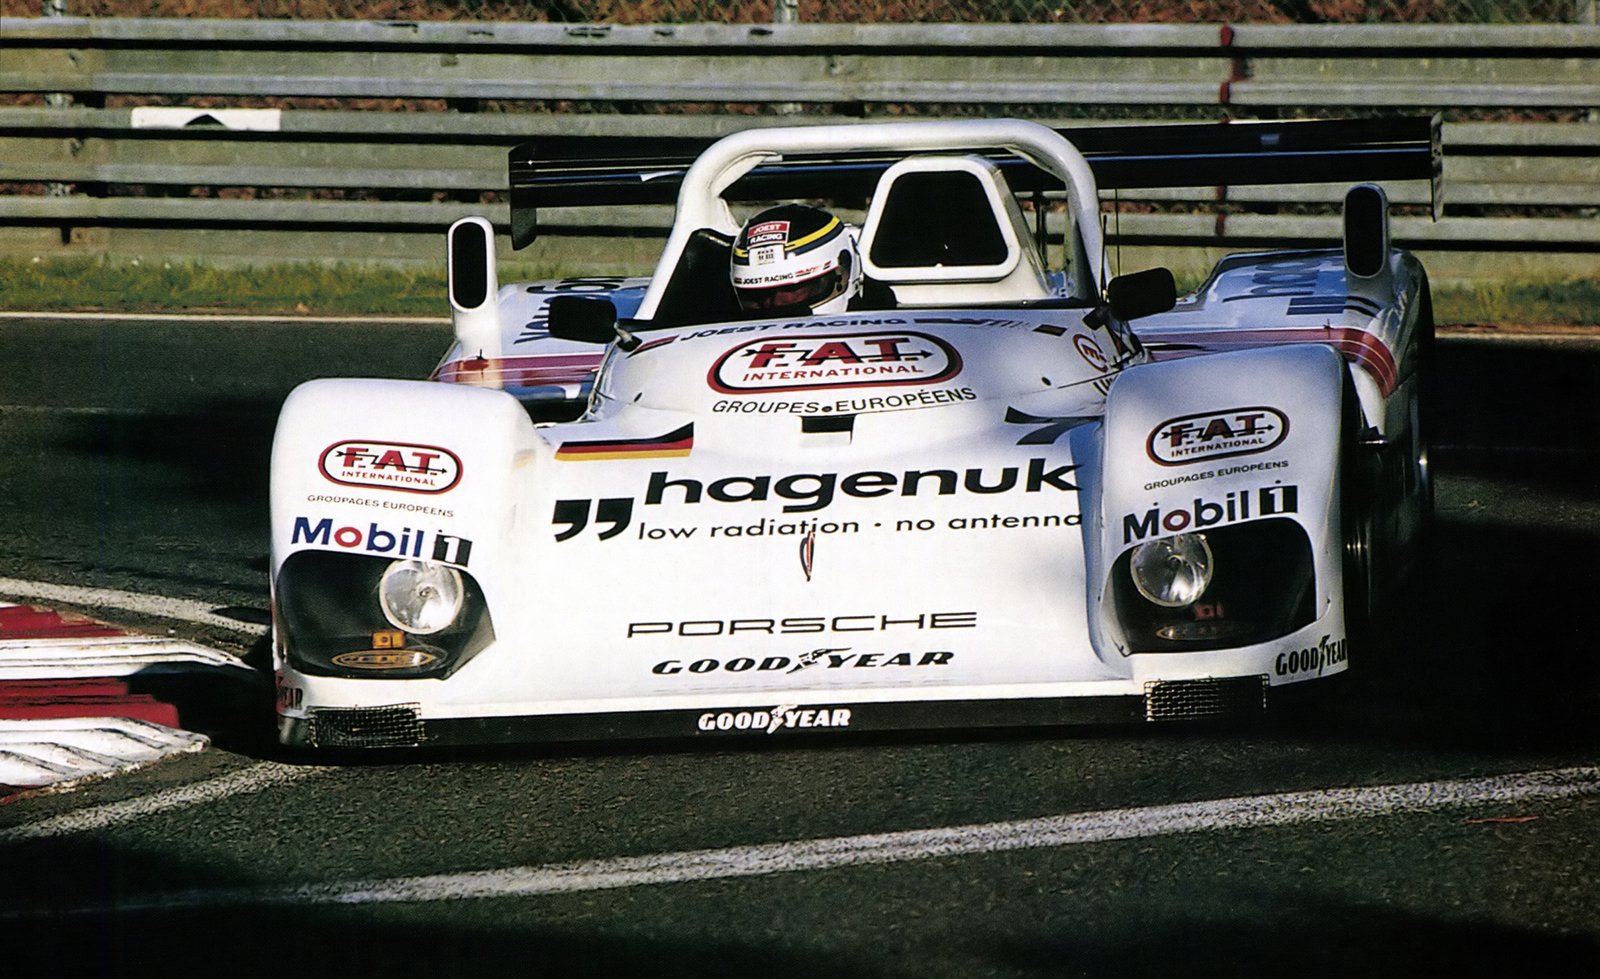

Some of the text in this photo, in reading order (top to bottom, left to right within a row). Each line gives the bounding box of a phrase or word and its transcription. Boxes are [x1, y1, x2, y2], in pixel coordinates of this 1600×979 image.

[750, 233, 783, 244] RACING
[753, 224, 781, 234] JOEST
[743, 273, 794, 285] JOEST RACING
[680, 318, 907, 341] JOEST RACING
[742, 364, 924, 382] INTERNATIONAL
[712, 387, 977, 414] GROUPES EUROPÉENS
[1171, 437, 1265, 457] INTERNATIONAL
[341, 470, 436, 486] INTERNATIONAL
[644, 458, 1083, 513] hagenuk
[1144, 460, 1289, 491] GROUPAGES EUROPÉENS
[307, 494, 379, 507] GROUPAGES
[638, 514, 1082, 541] low radiation no antenna
[1123, 490, 1249, 544] Mobil
[291, 517, 425, 558] Mobil
[626, 612, 977, 638] PORSCHE
